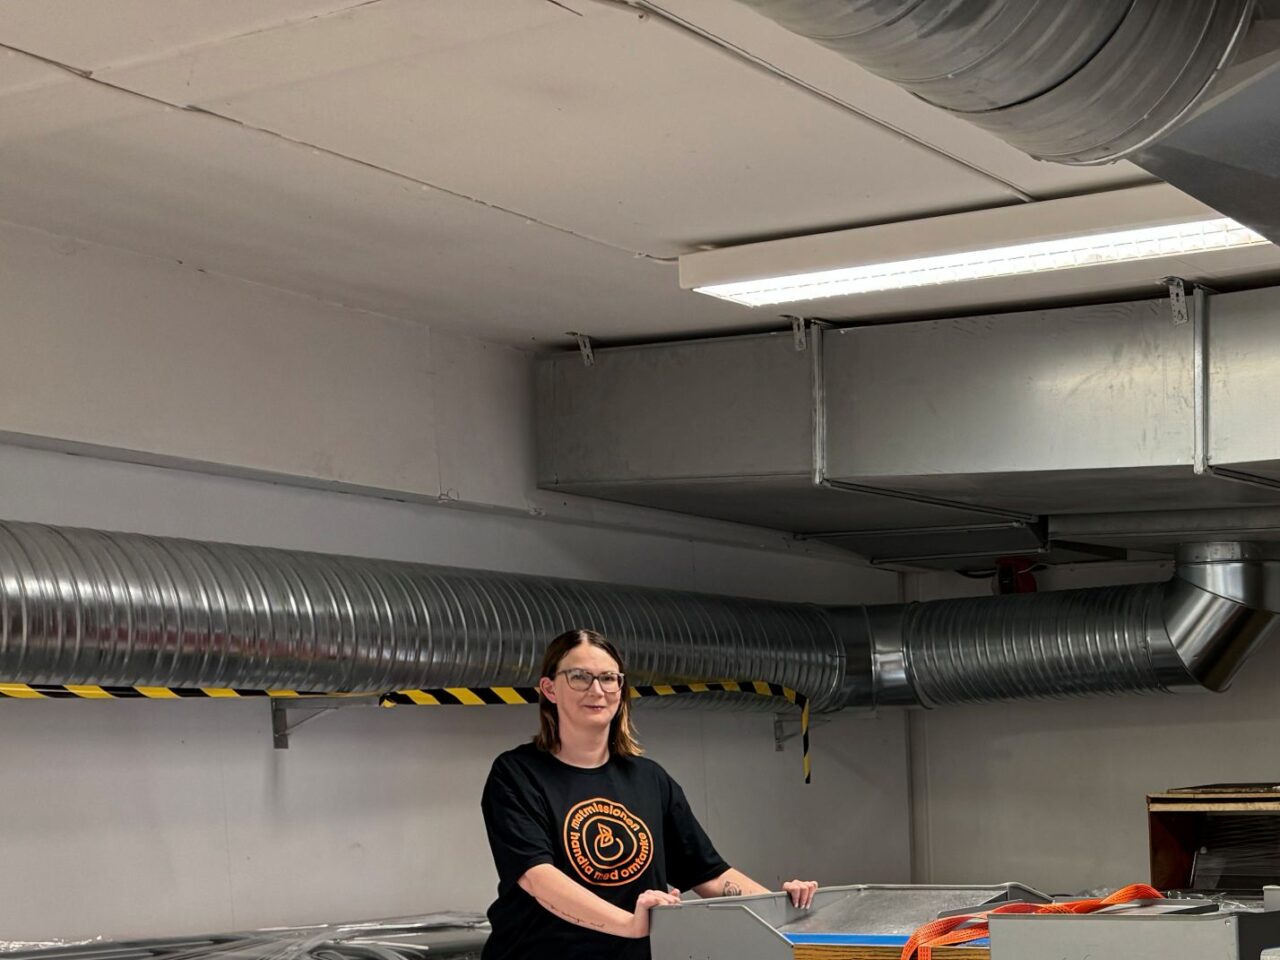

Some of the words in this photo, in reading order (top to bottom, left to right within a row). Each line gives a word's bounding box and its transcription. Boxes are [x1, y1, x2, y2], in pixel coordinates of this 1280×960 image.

[570, 802, 640, 831] matmissionen
[570, 831, 594, 875] handla
[620, 831, 649, 877] omtanke
